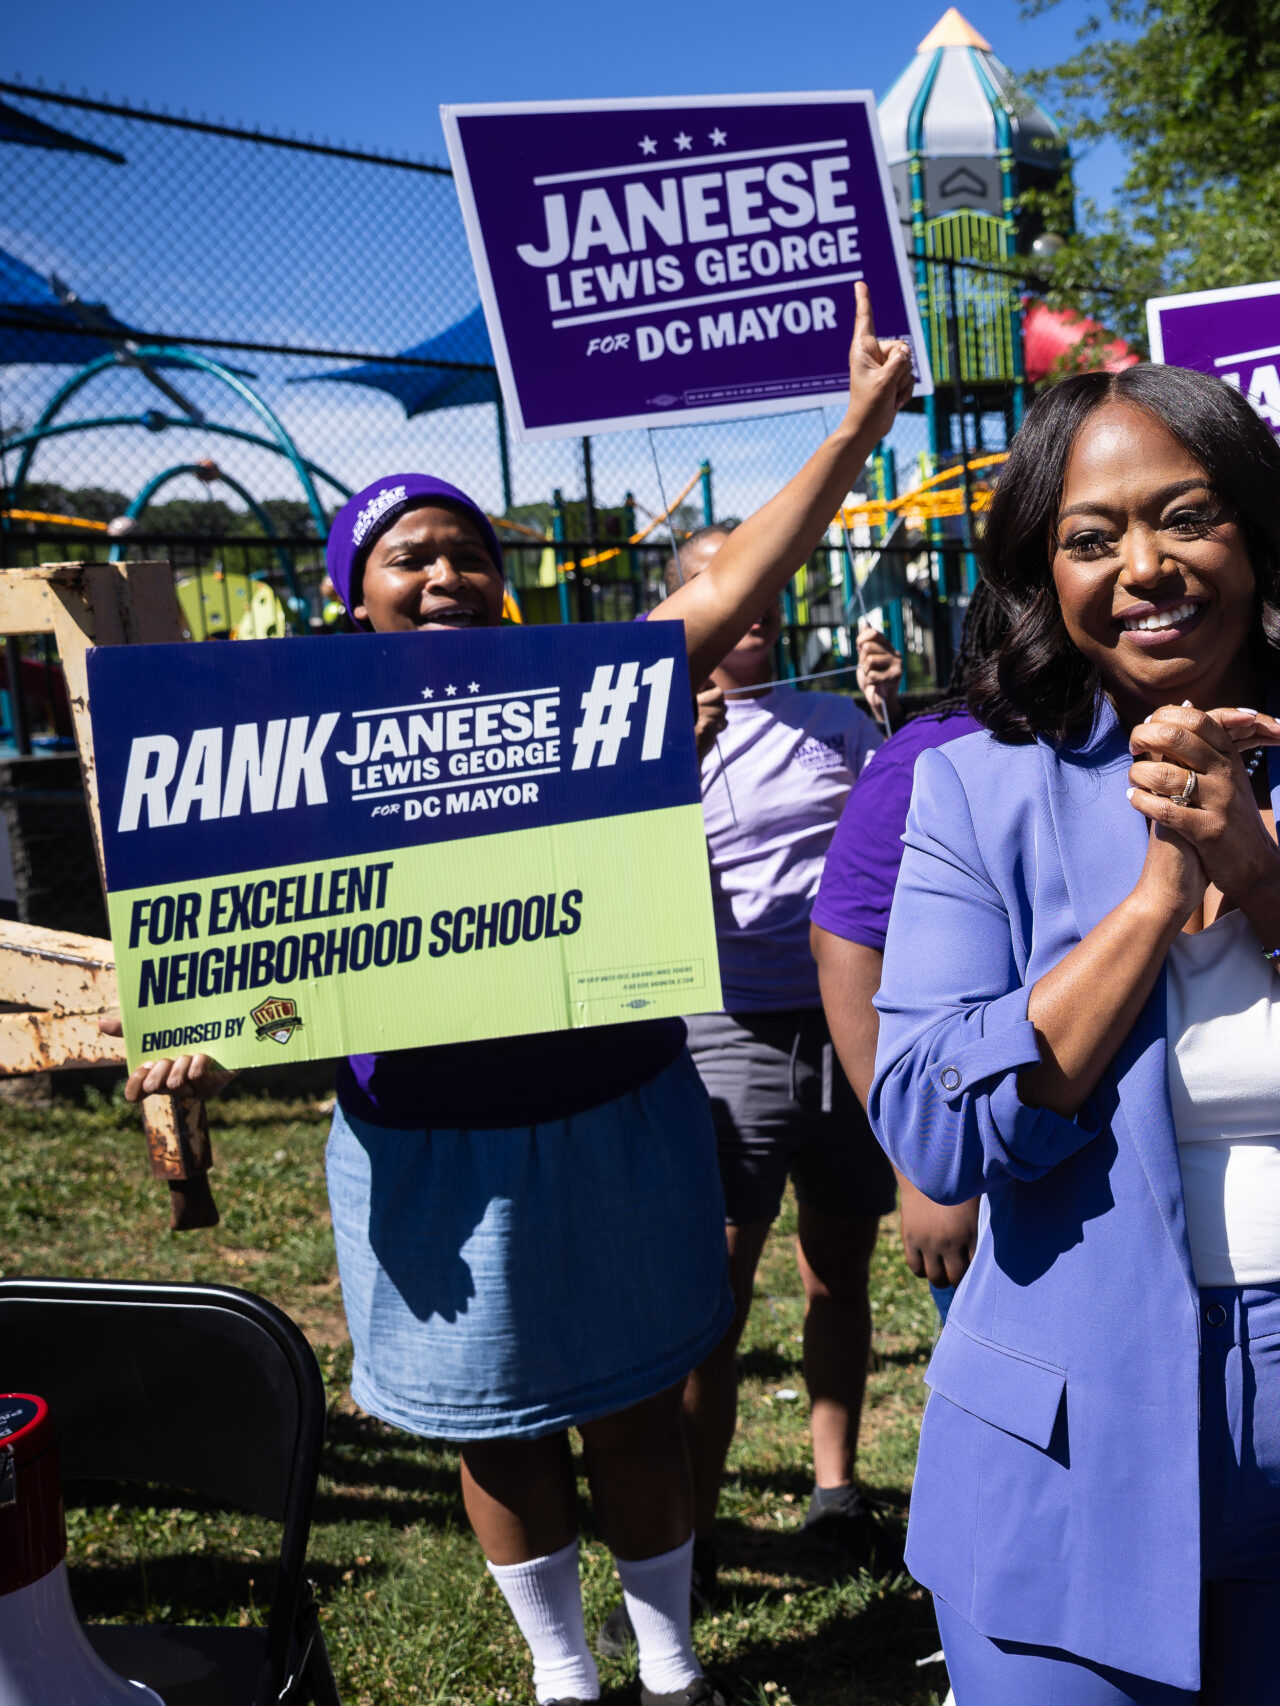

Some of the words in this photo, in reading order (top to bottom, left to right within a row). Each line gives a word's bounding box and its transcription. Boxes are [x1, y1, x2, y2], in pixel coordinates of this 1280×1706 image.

[516, 155, 856, 268] JANEESE
[546, 254, 684, 312] LEWIS
[695, 226, 862, 287] GEORGE
[586, 332, 630, 358] FOR
[636, 320, 693, 362] DC
[699, 297, 837, 351] MAYOR
[335, 698, 561, 765] JANEESE
[571, 657, 675, 771] #1
[117, 711, 340, 833] RANK
[351, 761, 441, 791] LEWIS
[449, 739, 561, 778] GEORGE
[371, 803, 399, 819] FOR
[404, 796, 441, 822] DC
[445, 783, 540, 816] MAYOR
[128, 889, 201, 950] FOR
[207, 860, 394, 938] EXCELLENT
[137, 914, 422, 1008] NEIGHBORHOOD
[428, 888, 584, 959] SCHOOLS
[141, 1020, 221, 1053] ENDORSED
[220, 1016, 247, 1040] BY
